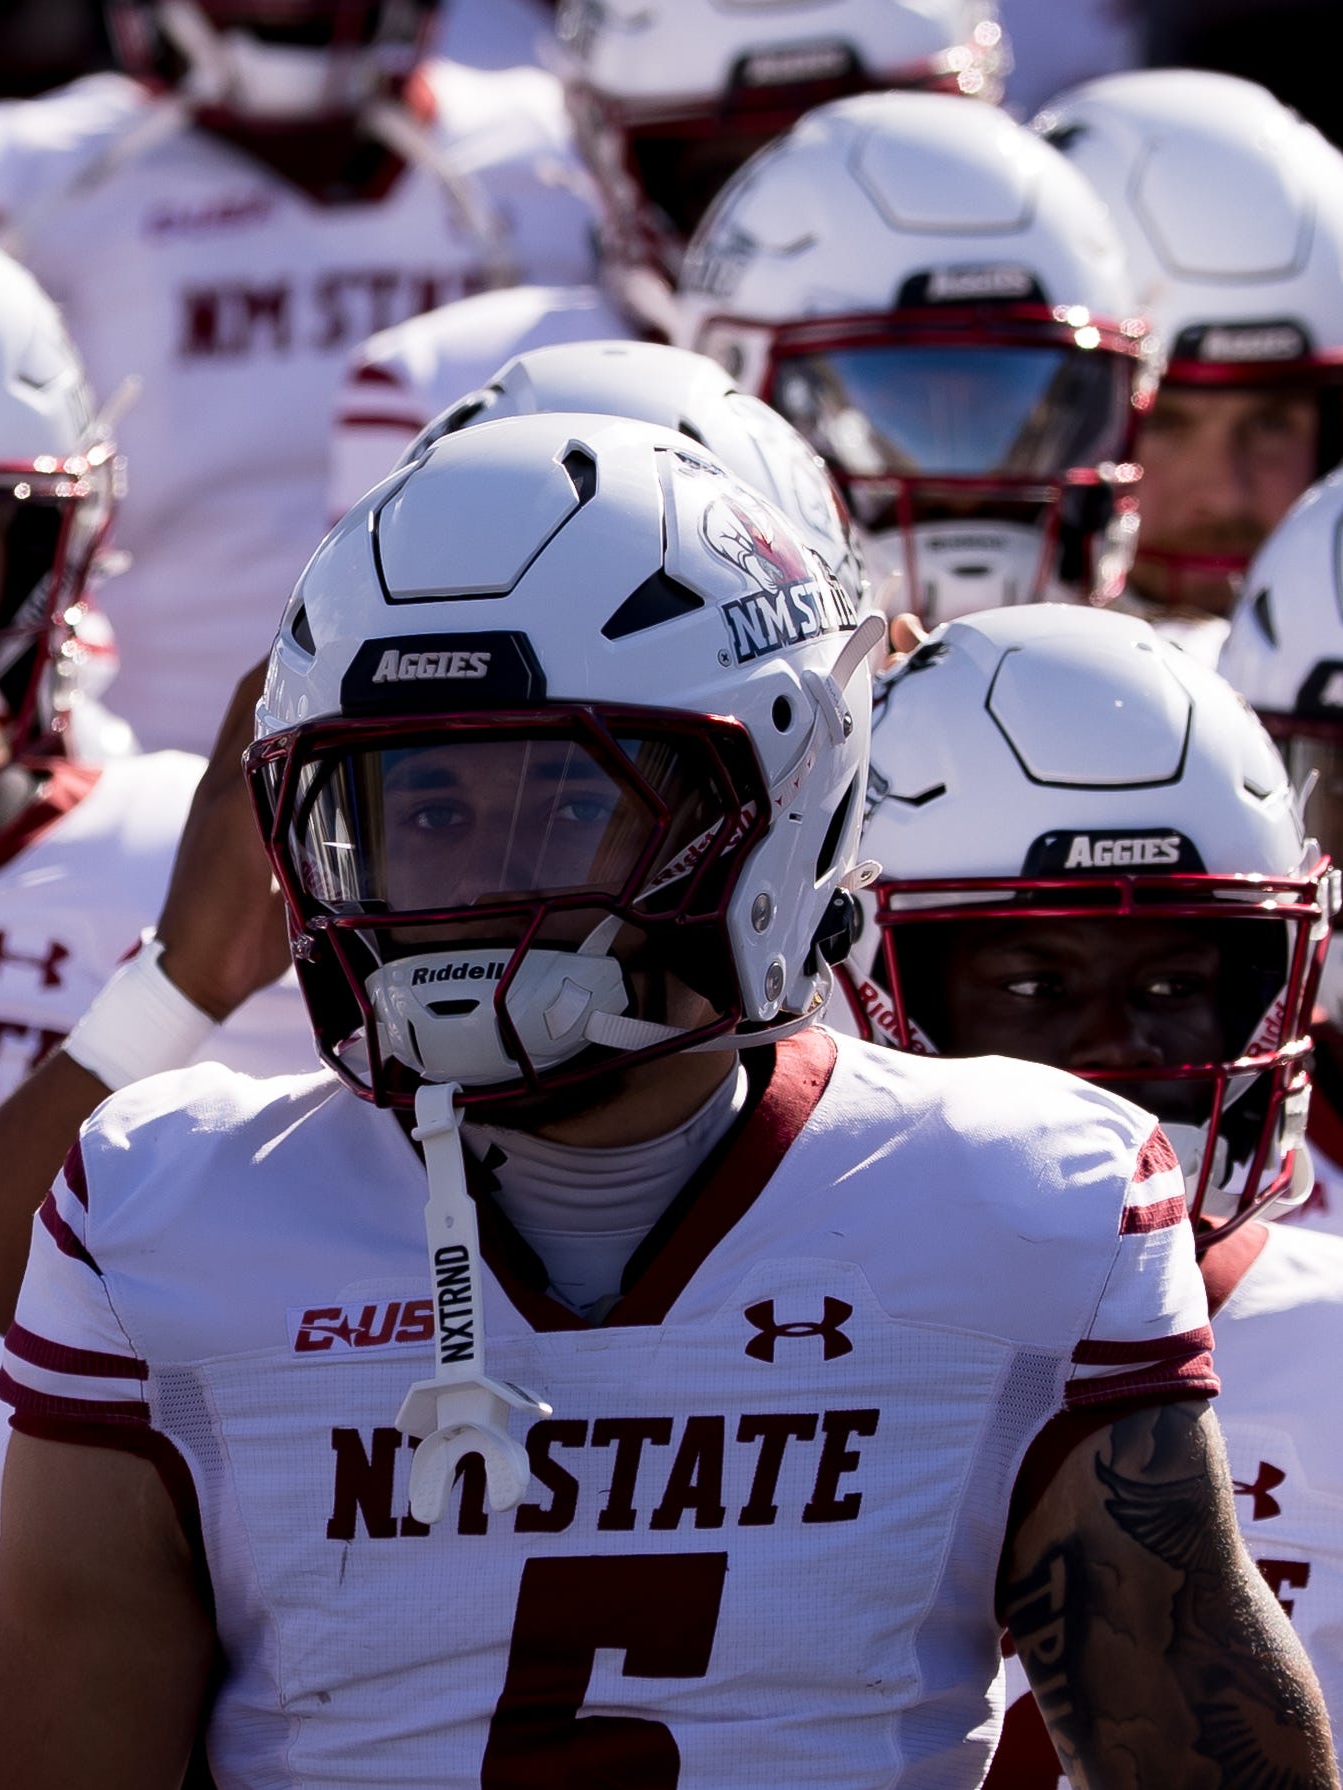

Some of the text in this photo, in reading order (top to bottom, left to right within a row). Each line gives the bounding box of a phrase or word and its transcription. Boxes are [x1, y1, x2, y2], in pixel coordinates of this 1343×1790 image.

[727, 591, 799, 656] NM
[371, 649, 492, 684] AGGIES
[1063, 835, 1181, 869] AGGIES
[411, 961, 506, 987] Riddell
[434, 1244, 475, 1364] NXTRND
[513, 1408, 880, 1534] STATE
